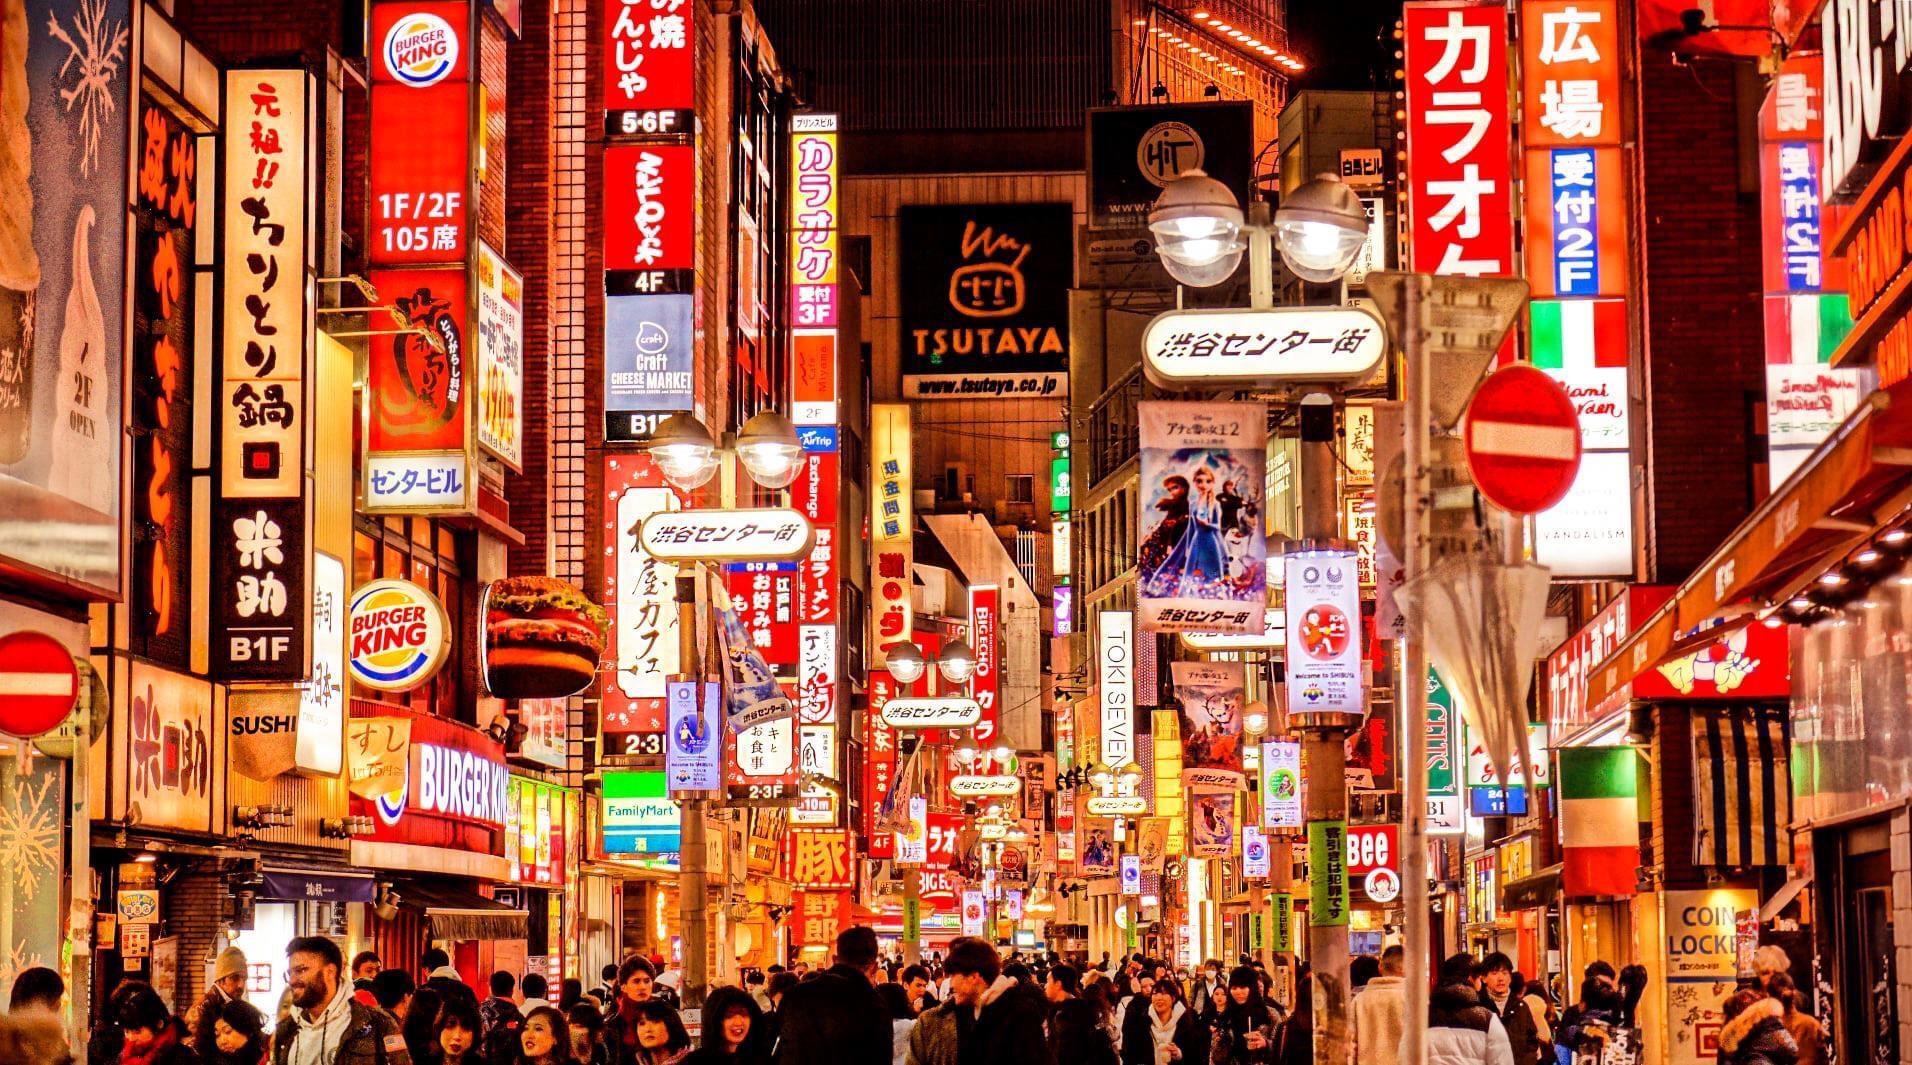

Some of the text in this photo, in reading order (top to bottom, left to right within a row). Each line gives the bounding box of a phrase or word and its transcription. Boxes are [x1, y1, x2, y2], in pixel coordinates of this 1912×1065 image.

[395, 30, 446, 53] BURGER
[397, 41, 448, 68] KING
[611, 0, 648, 99] んじゃ
[1539, 7, 1602, 138] 広場
[797, 138, 834, 281] カラオケ
[1554, 153, 1595, 293] 受付2F
[382, 225, 457, 251] 105席
[635, 272, 664, 292] 4F
[799, 286, 831, 303] 受付
[799, 304, 831, 323] 3F
[913, 327, 1063, 355] TSUTAYA
[1157, 328, 1371, 358] 渋谷センター街
[440, 319, 460, 403] とうがらし料理
[637, 354, 668, 371] Craft
[74, 371, 93, 408] 2F
[611, 373, 691, 389] CHEESE MARKET
[918, 378, 1057, 395] www.tsutaya.co.jp
[806, 408, 822, 418] 2F
[1577, 400, 1623, 417] rden
[70, 410, 95, 440] OPEN
[803, 435, 832, 447] AirTrip
[371, 468, 463, 495] センタービル
[809, 456, 820, 519] Exchange
[884, 459, 900, 536] 現金問屋
[651, 524, 800, 544] 渋谷センター街
[1544, 530, 1626, 540] VANDALISM
[233, 510, 288, 617] 米助
[352, 605, 426, 629] BURGER
[753, 573, 771, 648] お好み焼
[1157, 608, 1251, 624] 渋谷センター街
[231, 637, 290, 661] B1F
[352, 622, 428, 659] KING
[976, 607, 989, 677] BIG ECHO
[1108, 630, 1125, 684] TOKI
[232, 716, 296, 735] SUSHI
[743, 704, 787, 723] 渋谷センター街
[886, 706, 975, 719] 渋谷センター街
[351, 724, 405, 755] すし
[751, 726, 763, 769] お食事
[420, 743, 490, 823] BURGER
[608, 803, 674, 817] FamilyMart
[1427, 802, 1446, 816] B1
[874, 839, 890, 849] 4F
[792, 831, 847, 945] 豚 野郎
[1682, 907, 1736, 926] COIN
